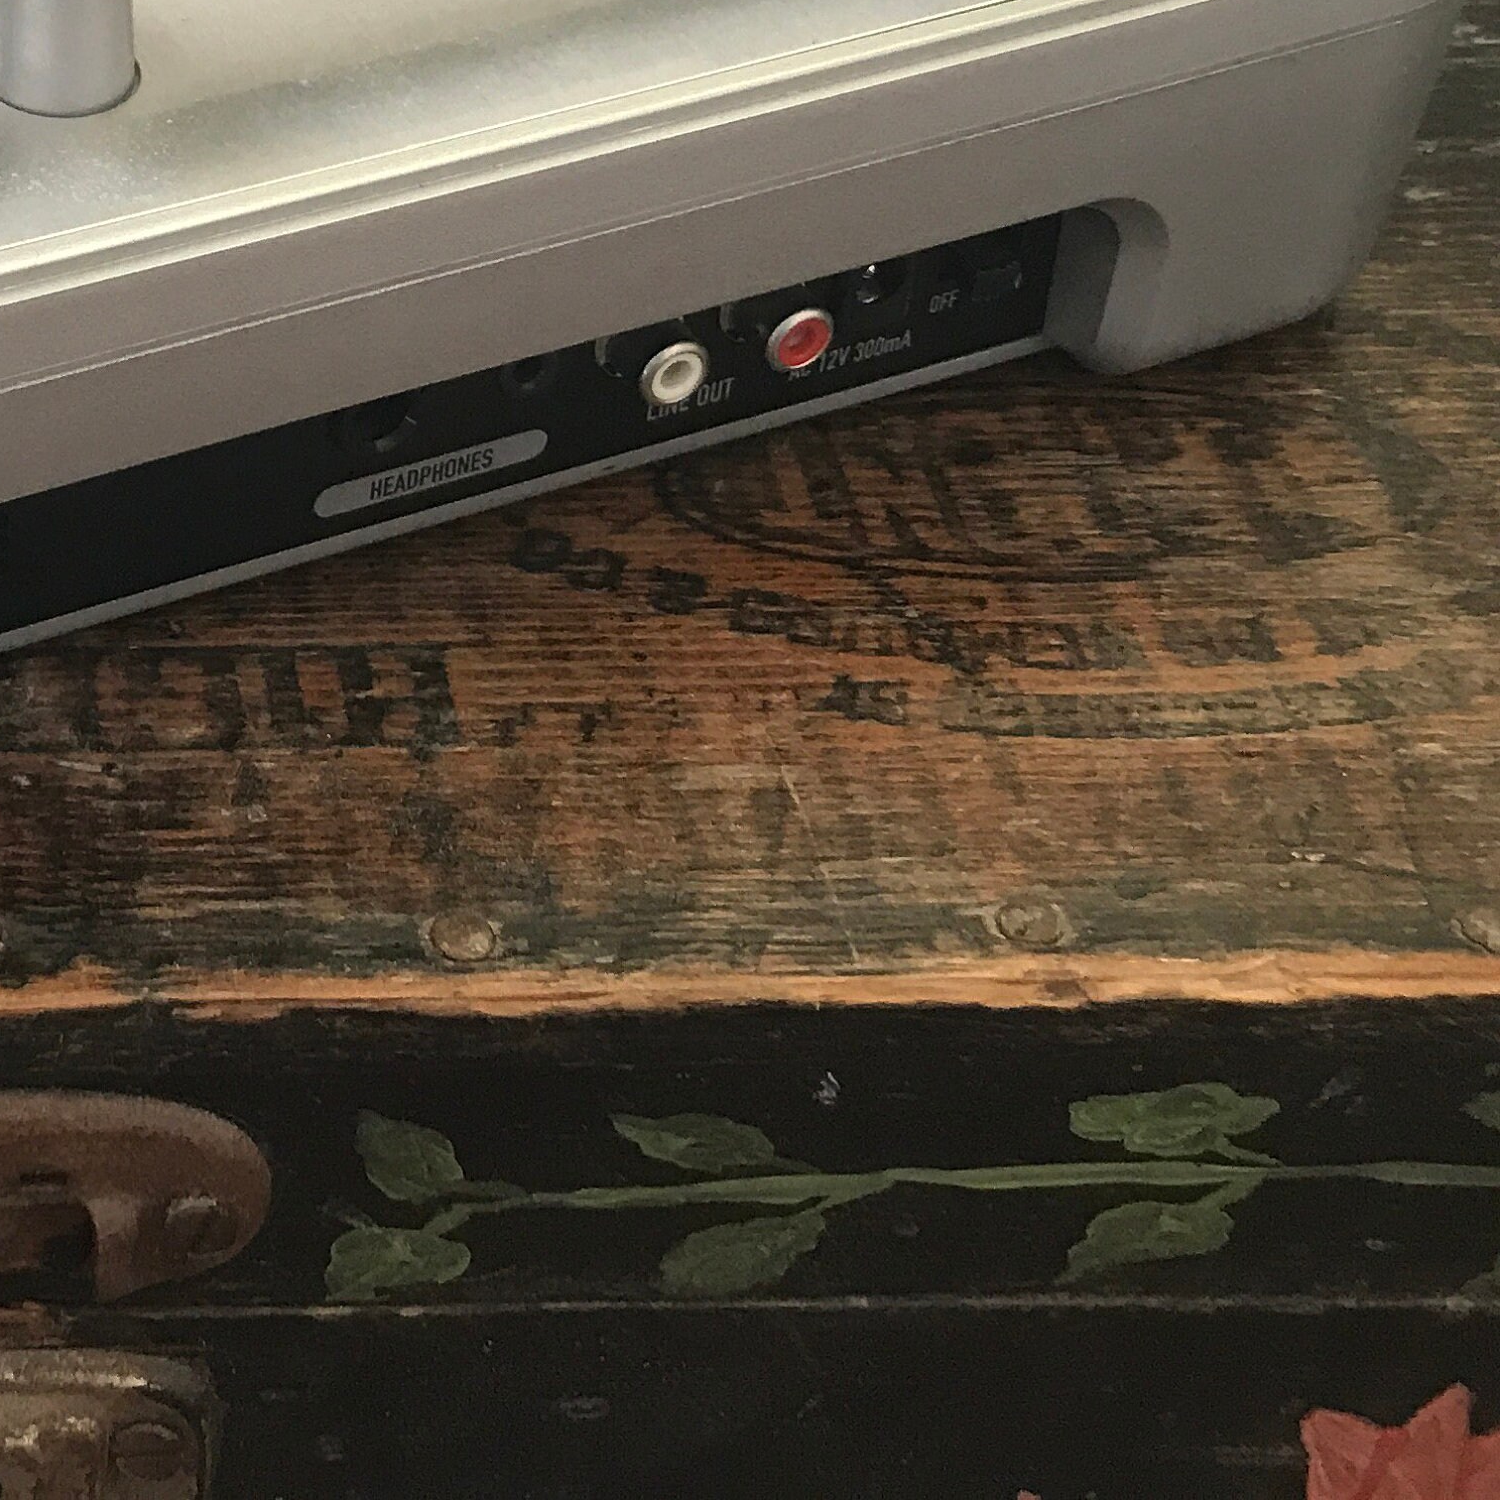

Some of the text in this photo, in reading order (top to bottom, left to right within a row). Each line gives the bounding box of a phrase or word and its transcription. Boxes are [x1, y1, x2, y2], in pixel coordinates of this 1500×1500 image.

[928, 289, 960, 314] OFF
[819, 347, 855, 373] 12V
[696, 377, 735, 408] OUT
[369, 448, 494, 501] HEADPHONES
